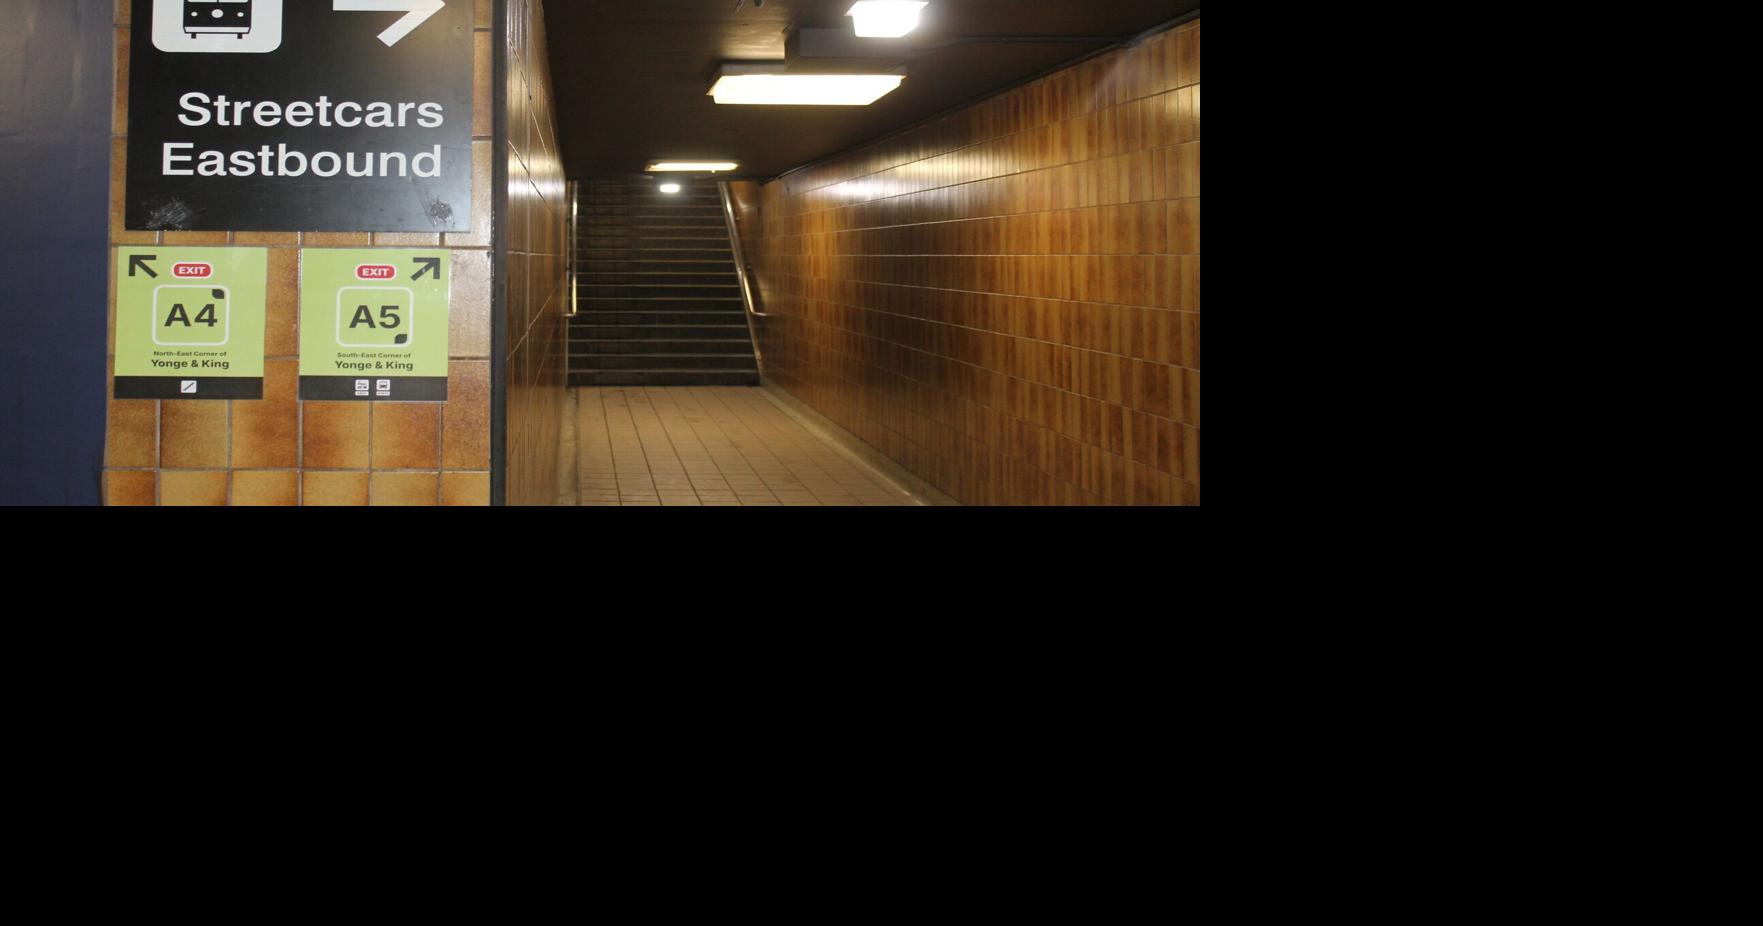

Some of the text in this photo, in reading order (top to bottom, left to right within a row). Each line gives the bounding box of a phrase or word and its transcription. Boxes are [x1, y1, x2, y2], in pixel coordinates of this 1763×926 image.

[177, 91, 444, 128] Streetcars
[161, 142, 441, 178] Eastbound
[178, 266, 206, 275] EXIT
[362, 268, 389, 277] EXIT
[164, 303, 218, 327] A4
[349, 305, 401, 329] A5
[151, 359, 229, 369] Yonge & King
[335, 361, 414, 371] Yonge & King
